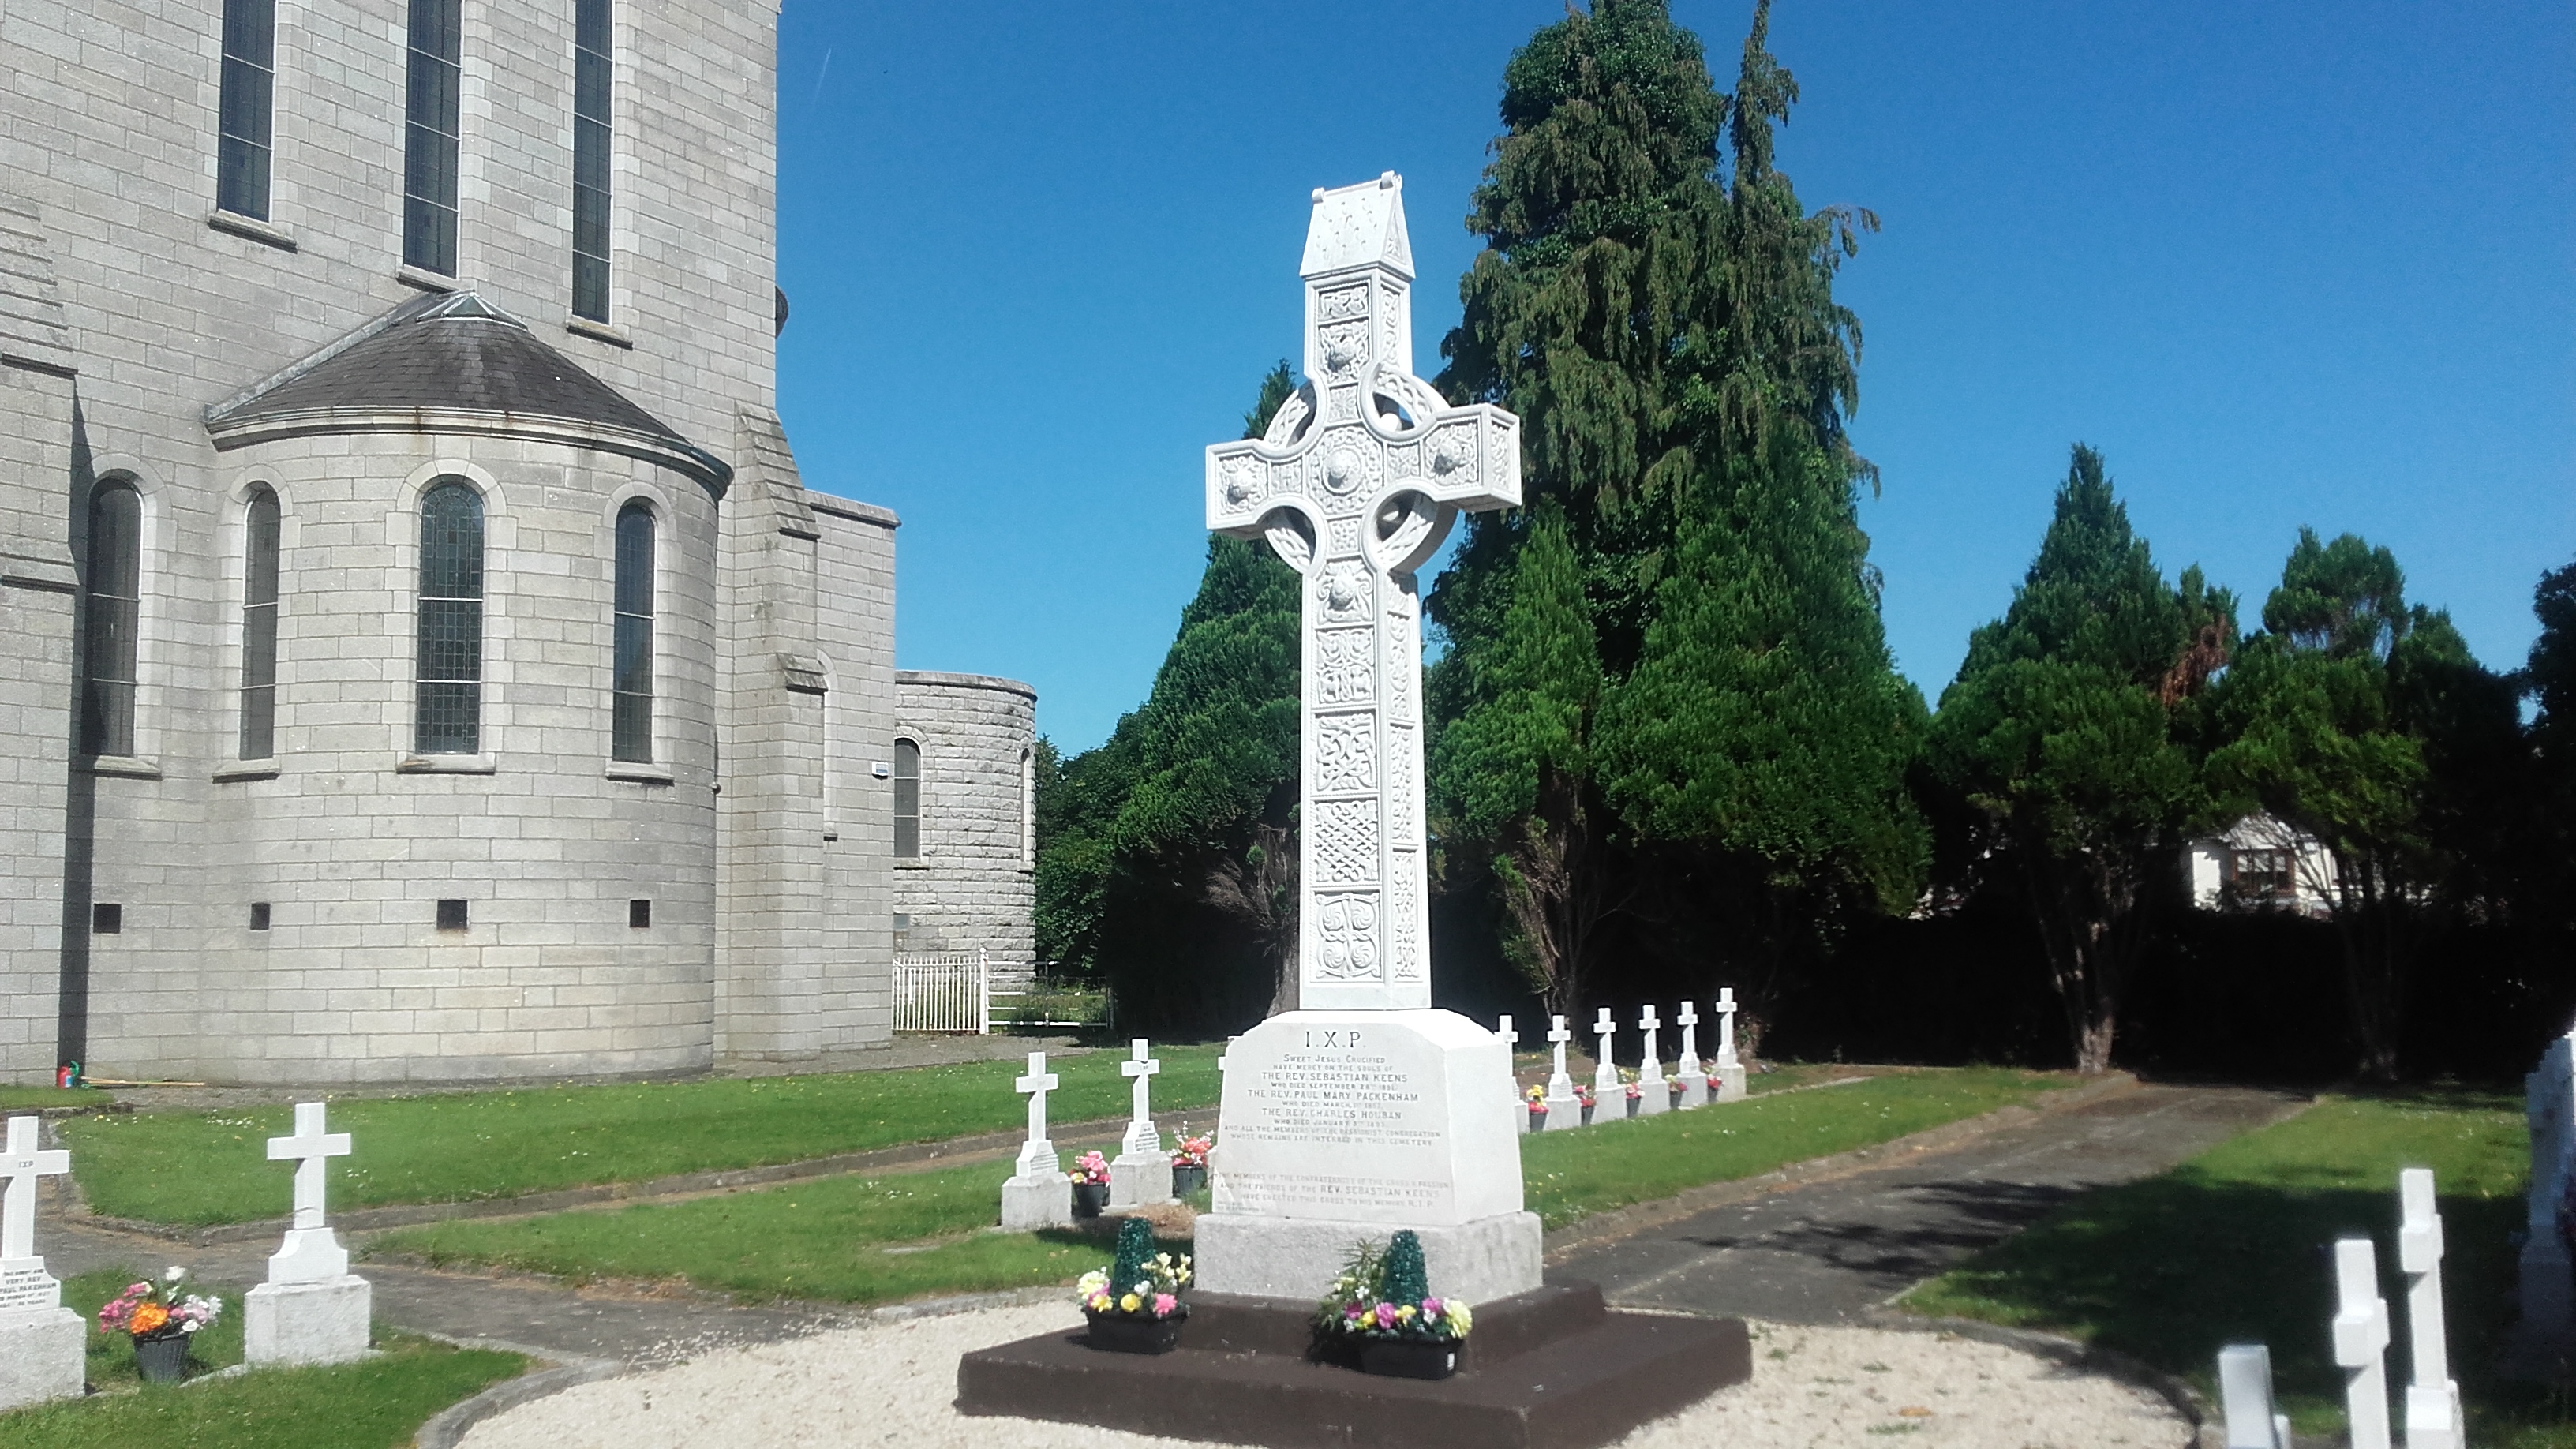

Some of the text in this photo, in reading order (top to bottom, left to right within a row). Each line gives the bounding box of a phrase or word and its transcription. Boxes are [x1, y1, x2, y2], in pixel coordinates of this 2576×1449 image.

[1374, 1074, 1408, 1083] KEENS
[1357, 1092, 1419, 1101] PACKENHAM
[1310, 1110, 1356, 1118] CHARLES
